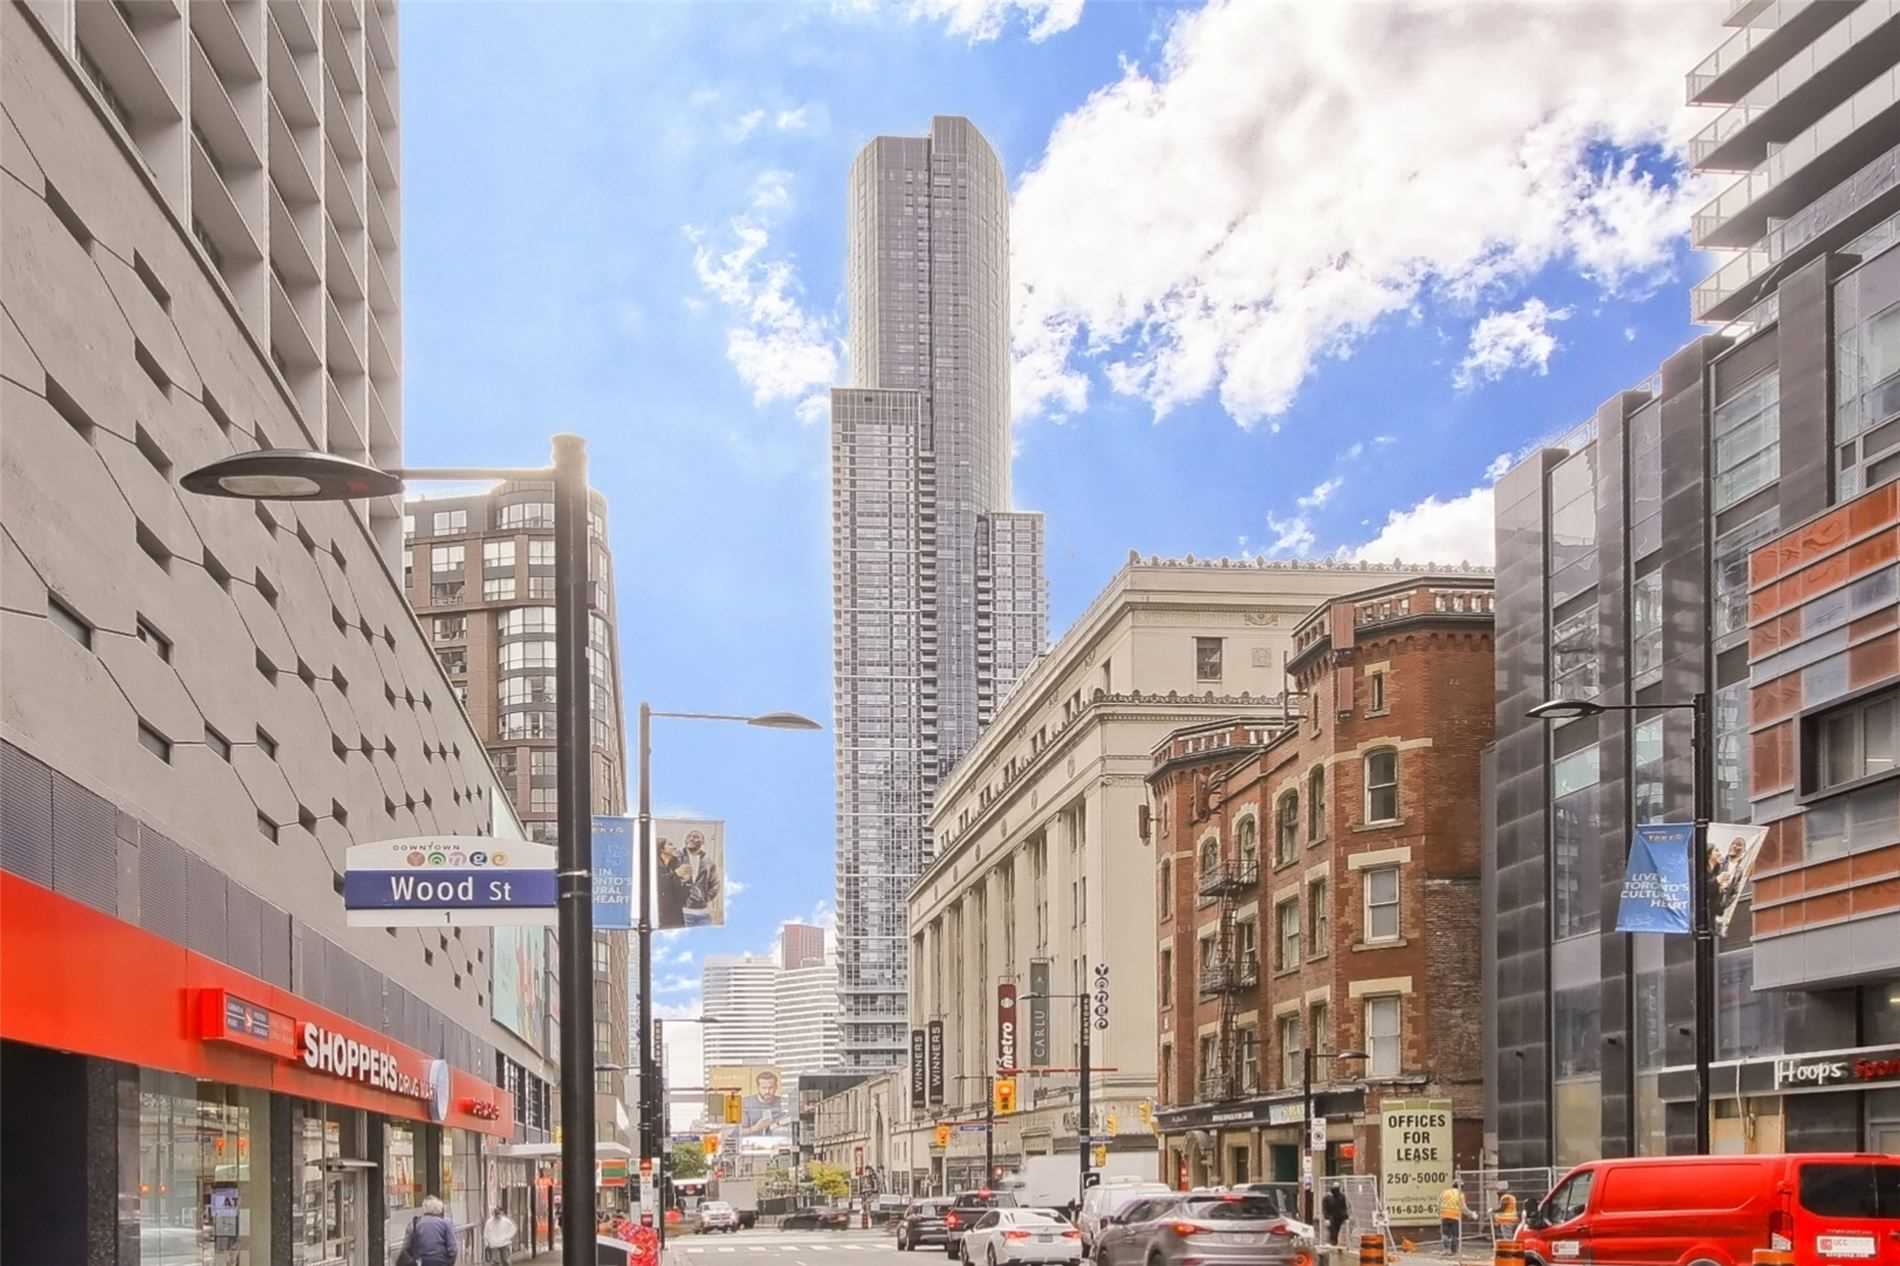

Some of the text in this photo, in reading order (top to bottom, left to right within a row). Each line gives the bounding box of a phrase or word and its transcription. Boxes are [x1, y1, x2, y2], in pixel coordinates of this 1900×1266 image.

[393, 842, 460, 851] DOWNTOWN
[391, 876, 512, 901] Wood St
[444, 911, 451, 924] 1
[1000, 1022, 1015, 1069] metro
[1034, 1010, 1046, 1058] CARLU
[303, 1021, 398, 1092] SHOPPERS
[914, 1035, 924, 1092] WINNERS
[931, 1026, 942, 1087] WINNERS
[1779, 1060, 1844, 1085] Hoops
[1388, 1114, 1446, 1129] OFFICES
[1403, 1131, 1431, 1145] FOR
[1397, 1148, 1438, 1161] LEASE
